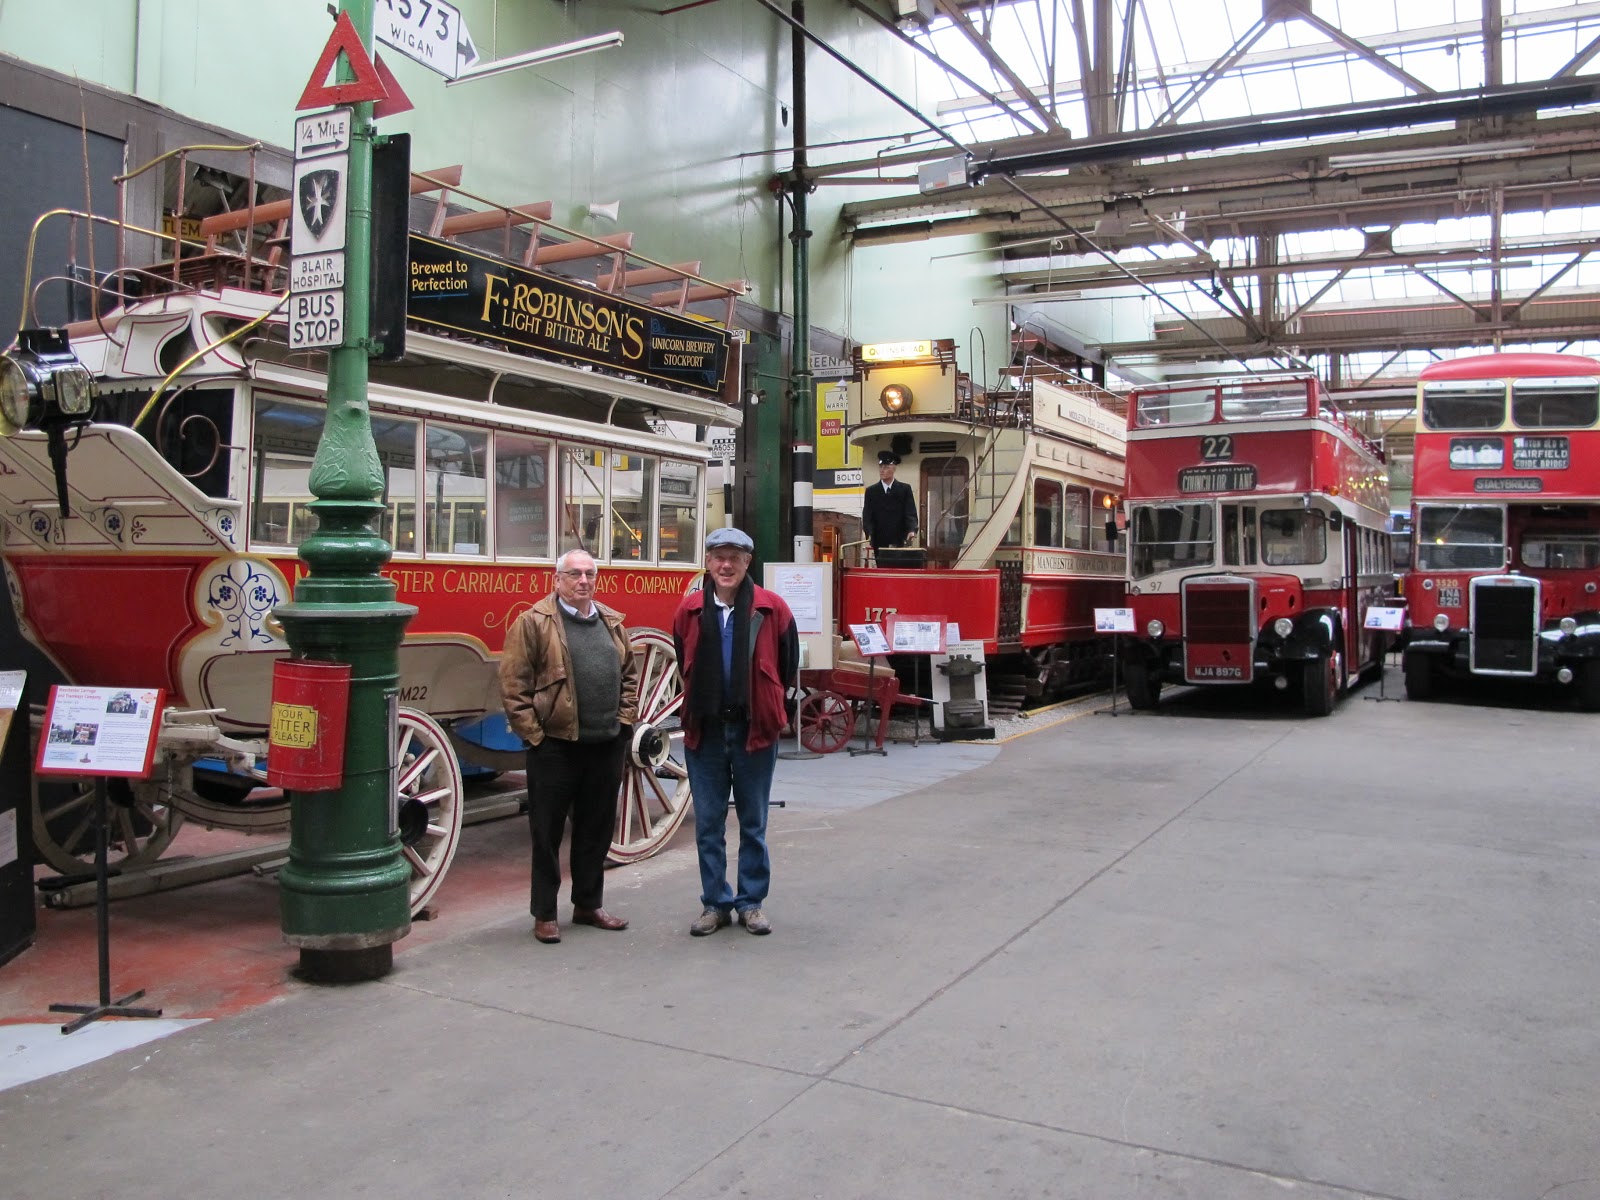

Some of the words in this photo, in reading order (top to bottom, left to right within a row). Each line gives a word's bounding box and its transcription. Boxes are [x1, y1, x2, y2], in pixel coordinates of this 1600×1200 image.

[391, 23, 434, 58] WIGAN
[319, 121, 345, 138] MILE
[302, 258, 333, 273] BLAIR
[411, 261, 453, 275] Brewed
[456, 260, 468, 273] to
[293, 272, 342, 289] HOSPITAL
[411, 278, 468, 291] Perfection
[299, 294, 335, 319] BUS
[293, 319, 340, 344] STOP
[502, 309, 542, 335] LIGHT
[545, 320, 585, 346] BITTER
[587, 332, 611, 353] ALE
[652, 337, 685, 352] UNICORN
[685, 340, 715, 354] BREWERY
[663, 353, 704, 368] STOCKPORT
[1204, 436, 1231, 458] 22
[1515, 449, 1568, 459] FAIRFIELD
[1233, 472, 1254, 490] LANE
[1476, 479, 1539, 490] STALYBRIDGE
[1037, 556, 1073, 570] MANCHESTER
[442, 569, 525, 594] CARRIAGE
[529, 573, 539, 593] &
[1150, 581, 1162, 591] 97
[1439, 589, 1460, 597] TNA
[1439, 597, 1460, 606] 520
[399, 685, 428, 701] M22
[277, 708, 303, 720] YOUR
[272, 718, 311, 733] LITTER
[274, 730, 305, 743] PLEASE
